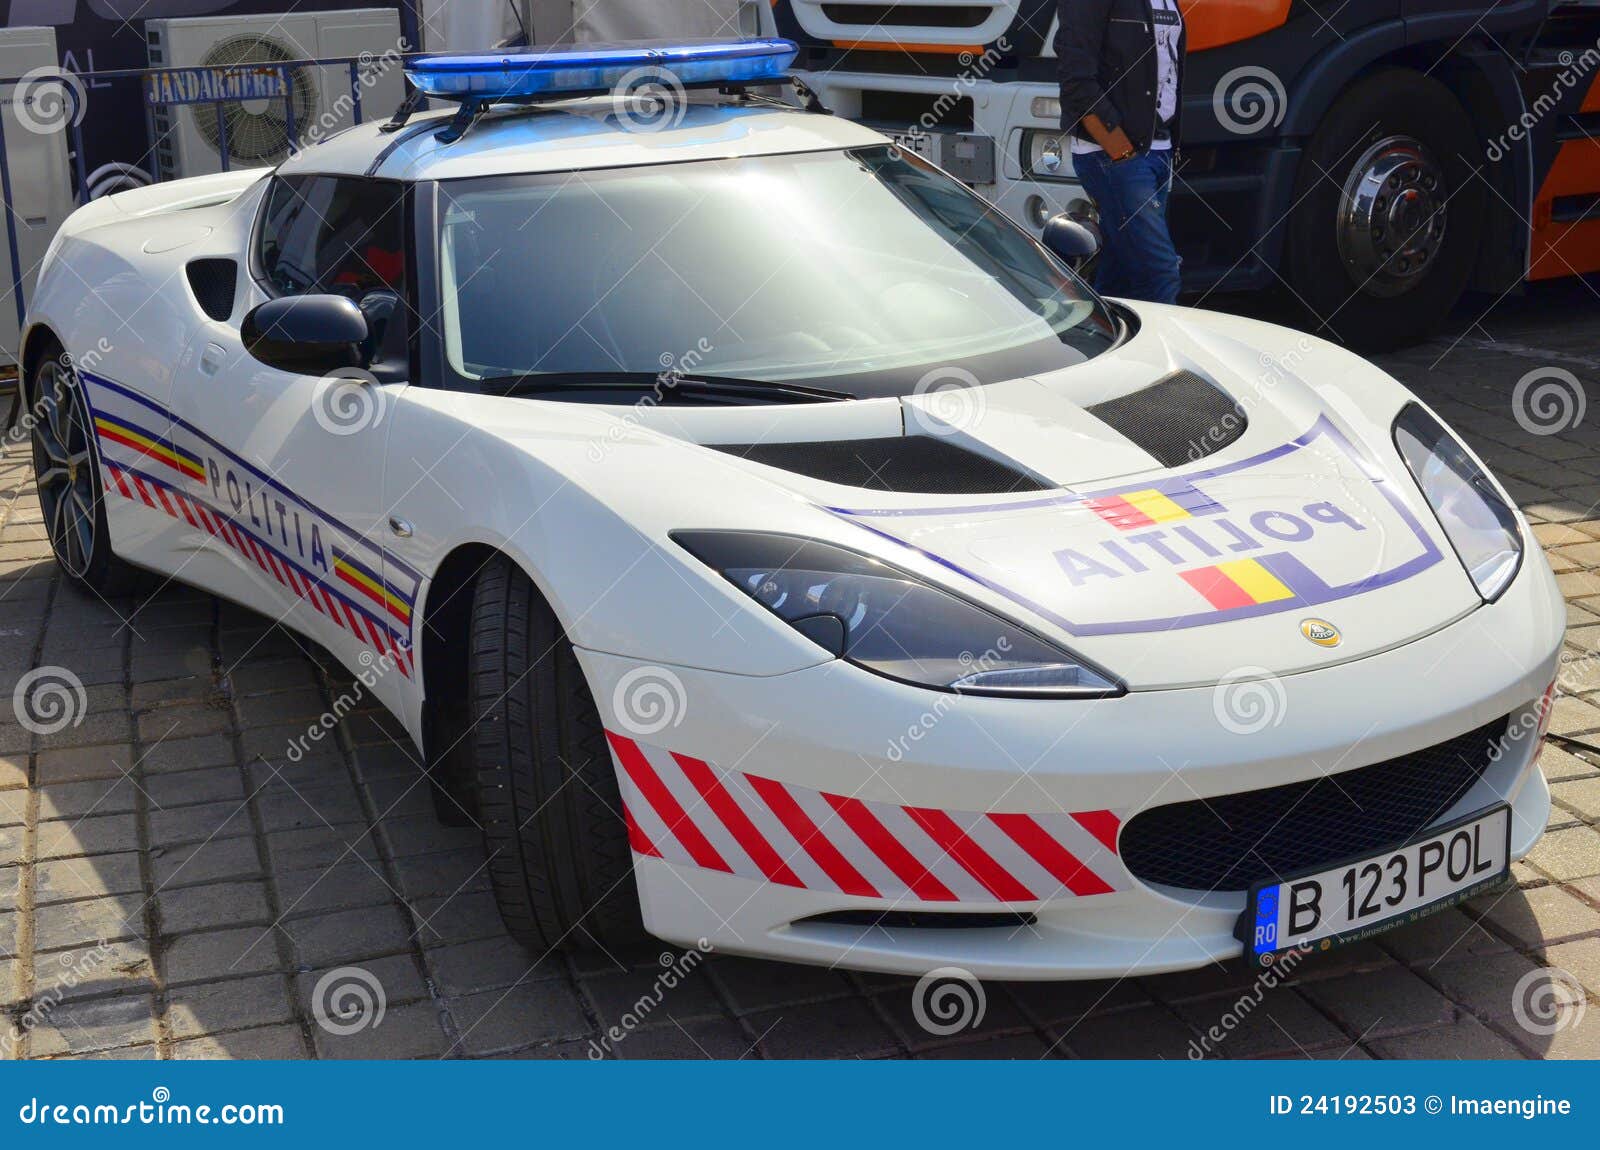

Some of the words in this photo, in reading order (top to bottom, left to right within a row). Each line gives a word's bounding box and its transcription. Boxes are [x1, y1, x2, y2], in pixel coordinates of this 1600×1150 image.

[149, 66, 288, 103] JANDARMERIA
[207, 456, 329, 573] POLITIA
[1288, 880, 1323, 938] B
[1342, 854, 1408, 921] 123
[1418, 824, 1493, 898] POL
[1254, 923, 1277, 947] RO
